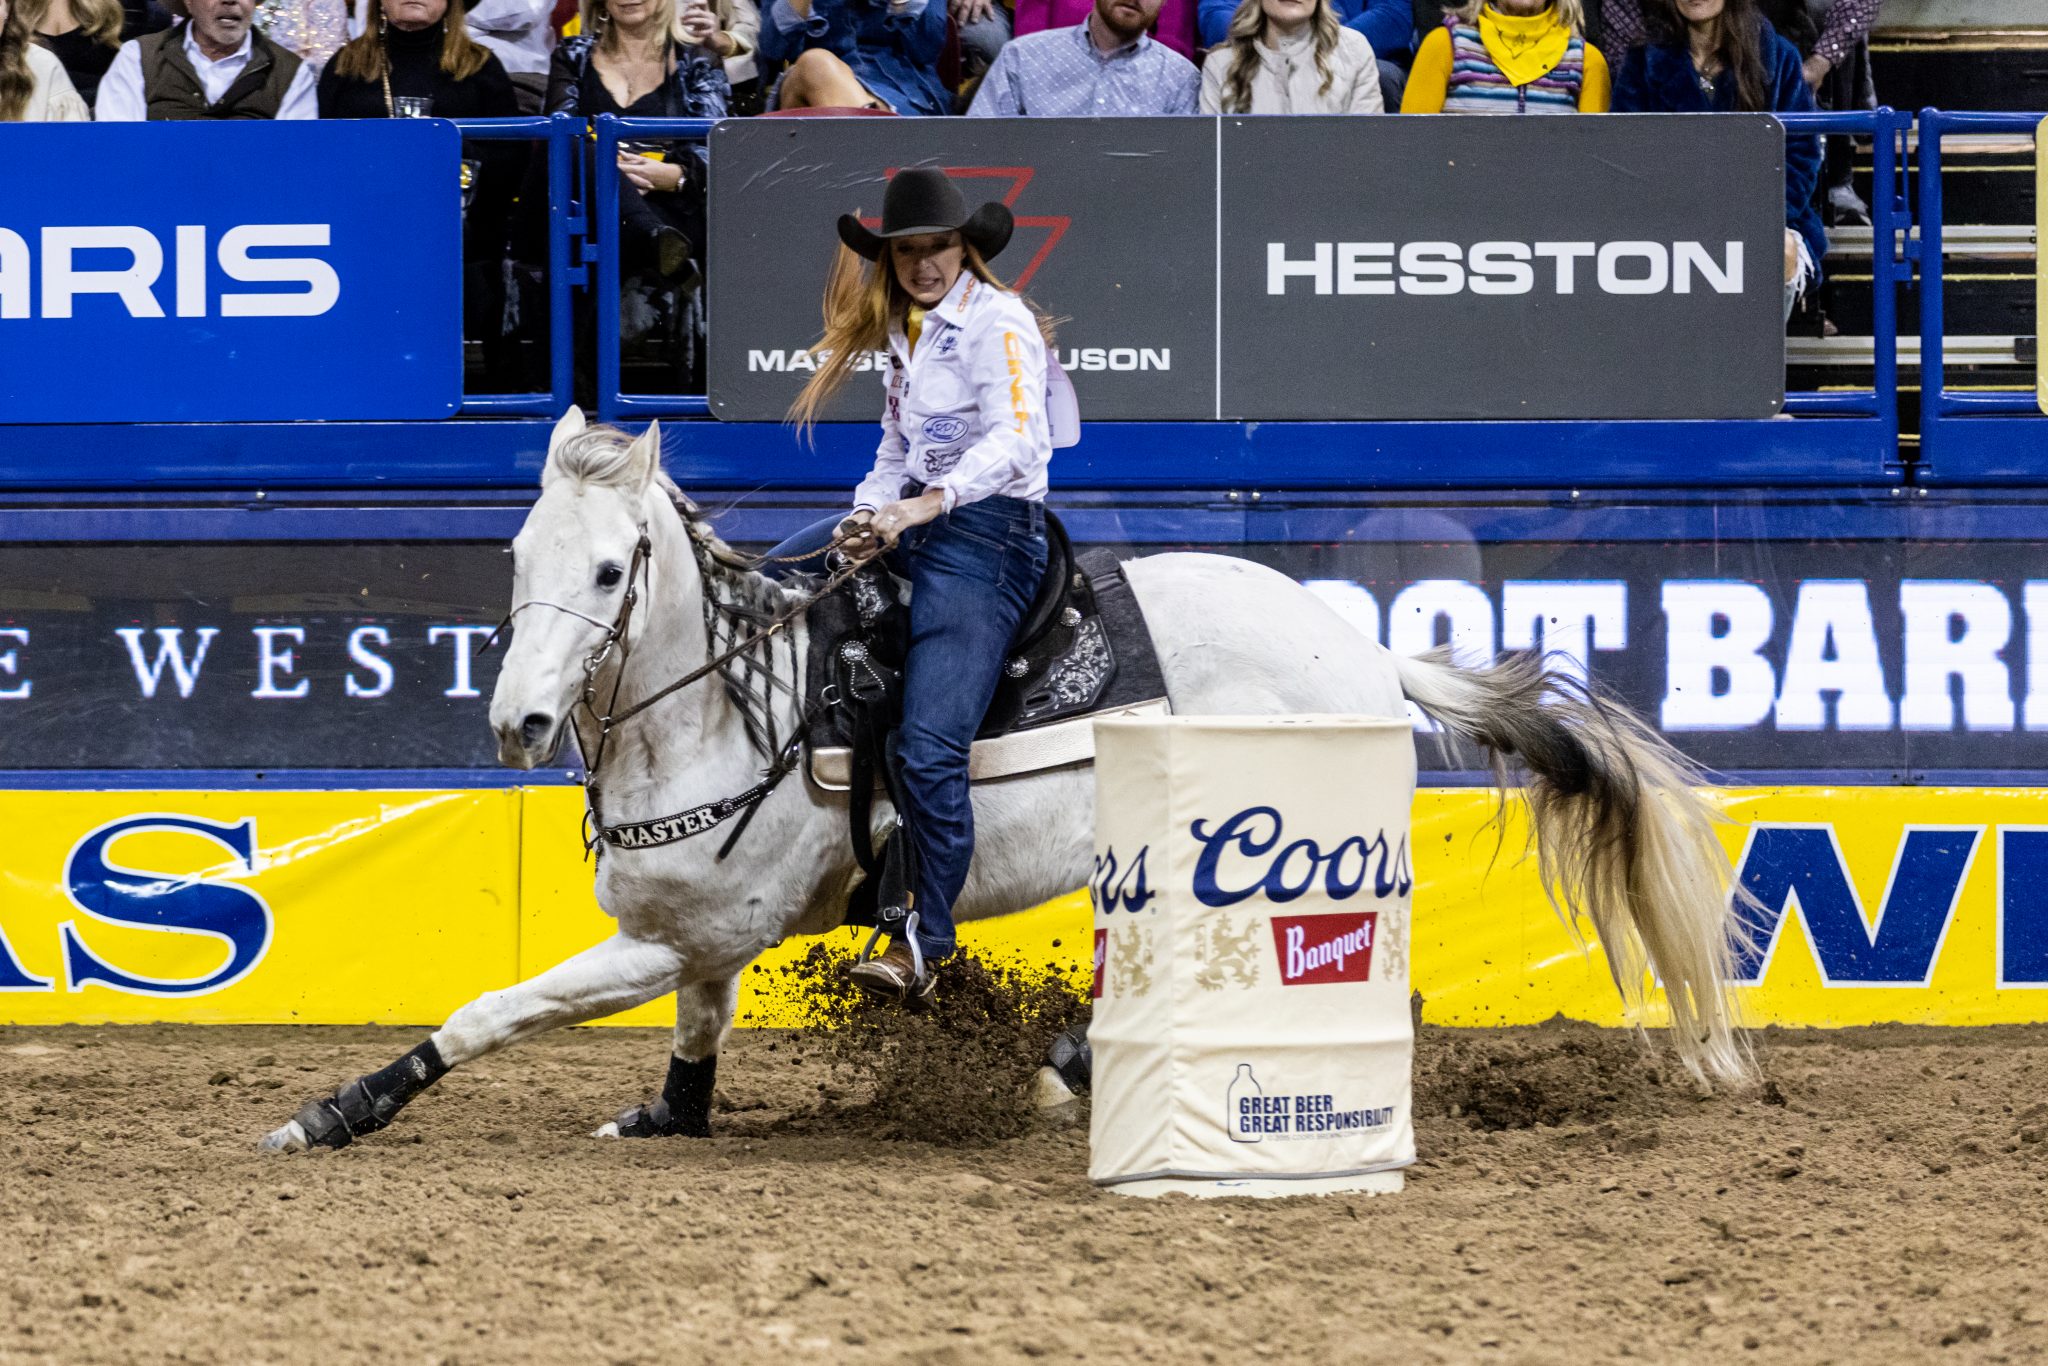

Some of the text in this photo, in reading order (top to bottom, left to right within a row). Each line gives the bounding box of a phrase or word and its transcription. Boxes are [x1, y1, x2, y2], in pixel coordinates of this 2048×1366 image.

[0, 224, 341, 319] RIS
[957, 275, 977, 313] CINC
[1266, 240, 1744, 295] HESSTON
[1054, 347, 1171, 371] USON
[115, 627, 499, 698] WEST
[1661, 578, 2048, 732] BAR
[618, 807, 718, 847] MASTER
[0, 811, 275, 999] S
[1655, 821, 2048, 989] W
[1286, 919, 1372, 979] Banquet
[1239, 1094, 1333, 1114] GREAT BEER
[1240, 1115, 1290, 1133] GREAT
[1295, 1106, 1394, 1132] RESPONSIBILITY
